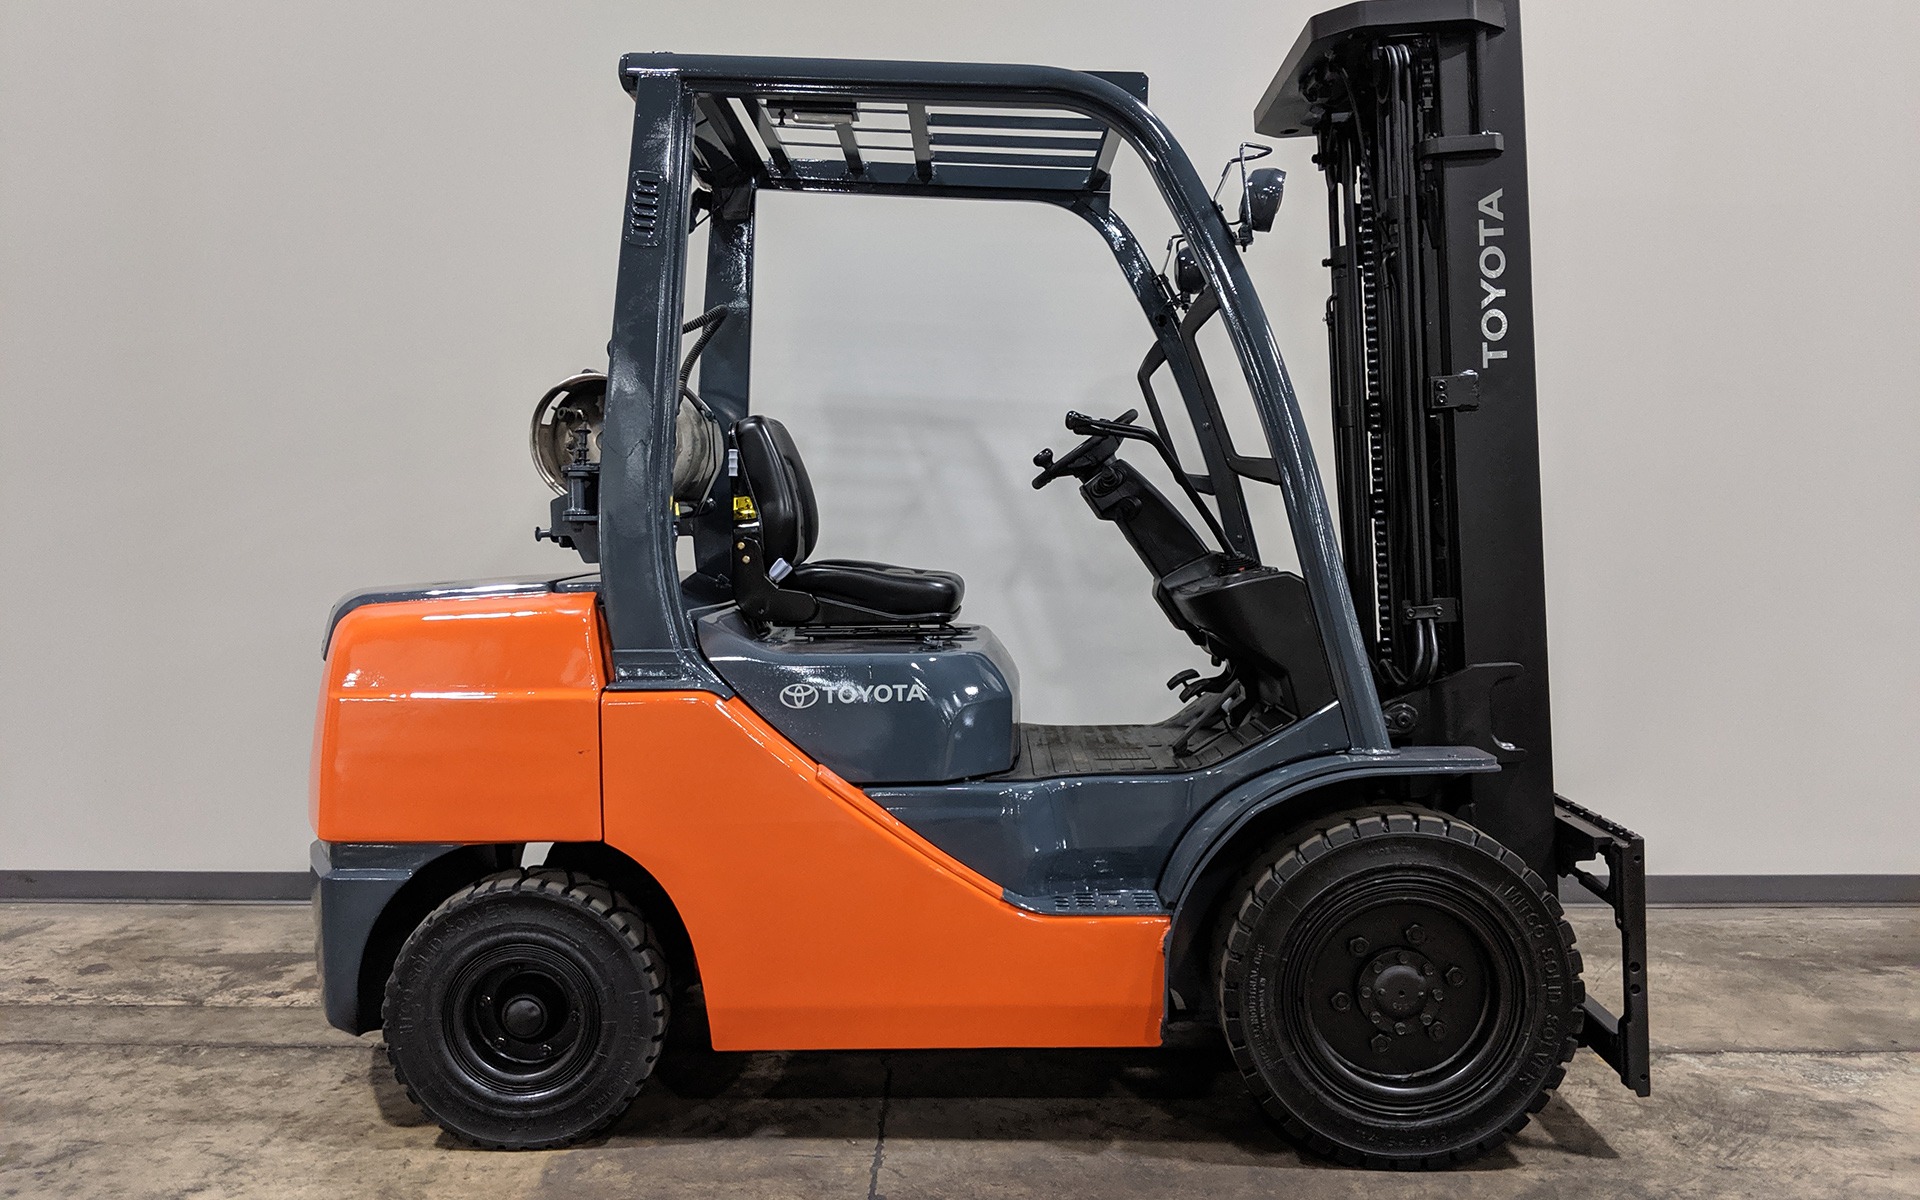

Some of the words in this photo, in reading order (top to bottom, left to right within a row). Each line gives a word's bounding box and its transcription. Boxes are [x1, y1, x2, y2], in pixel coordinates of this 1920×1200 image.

[1478, 188, 1508, 369] TOYOTA
[822, 684, 925, 704] TOYOTA
[1542, 948, 1562, 1002] SOLID
